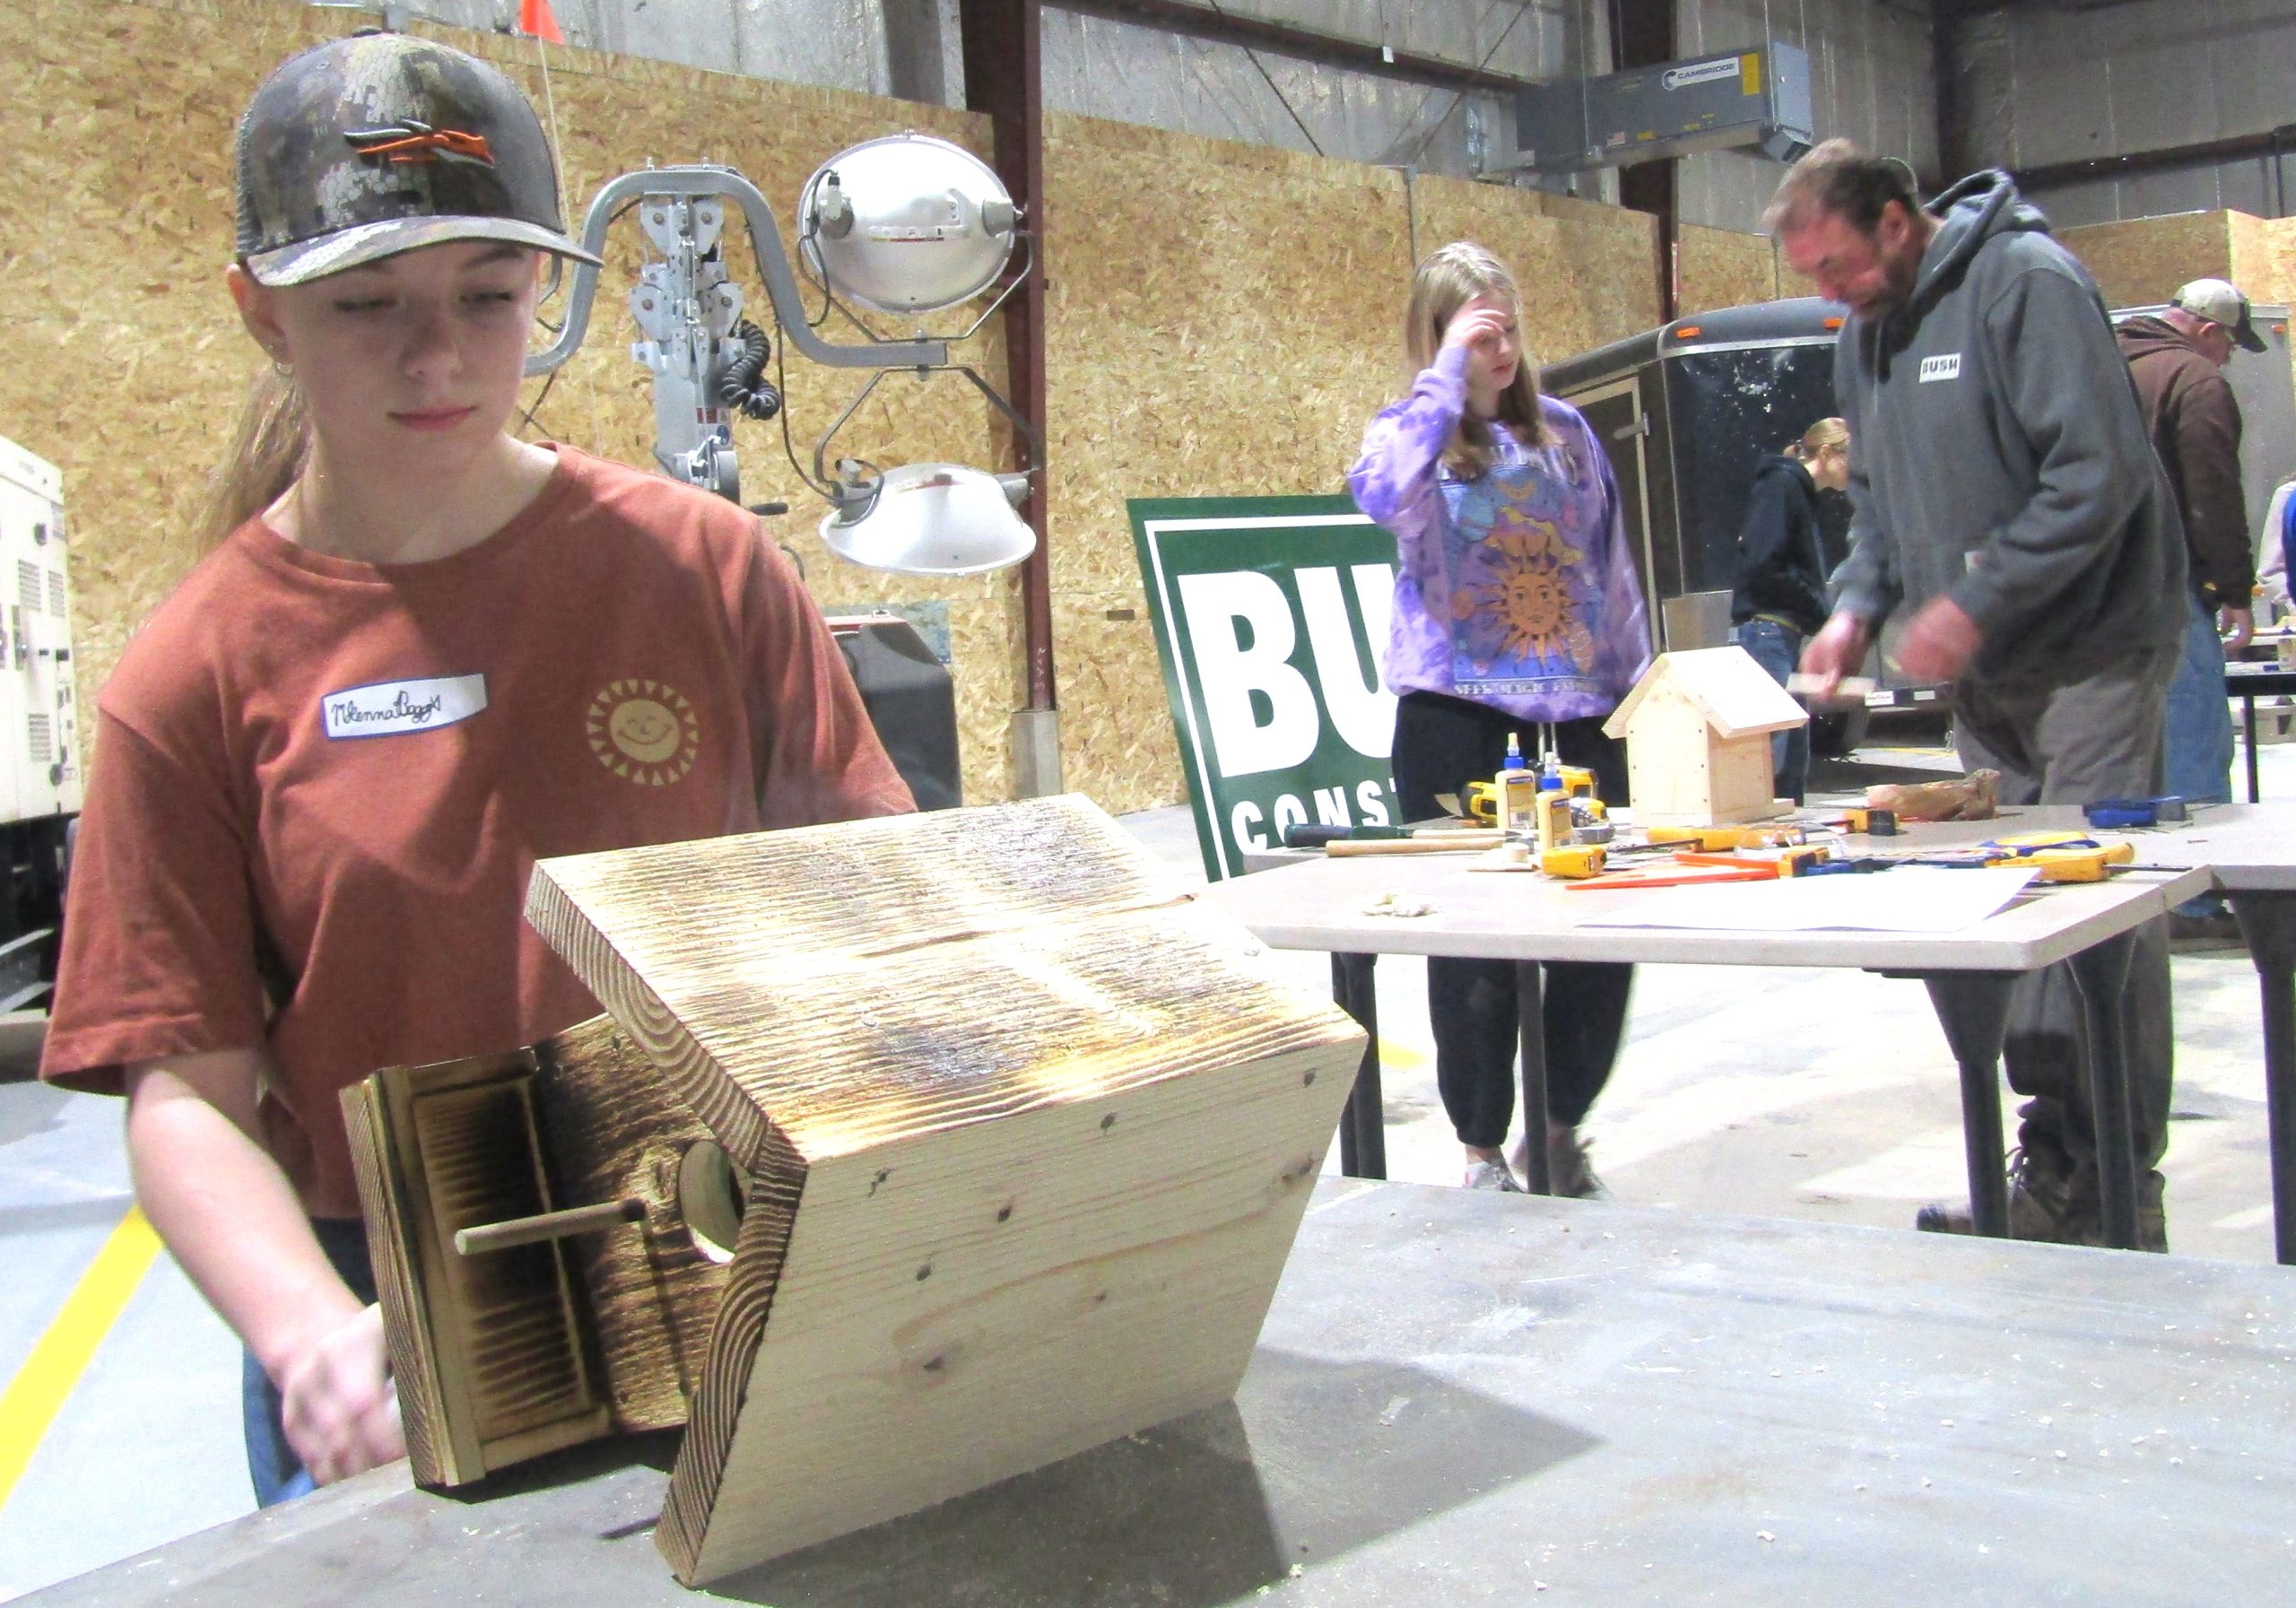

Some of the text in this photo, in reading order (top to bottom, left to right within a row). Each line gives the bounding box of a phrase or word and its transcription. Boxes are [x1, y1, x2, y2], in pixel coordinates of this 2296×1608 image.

[1677, 63, 1735, 80] CAMBRIDGE
[1922, 357, 1959, 374] BUSH
[1231, 778, 1399, 856] CONS
